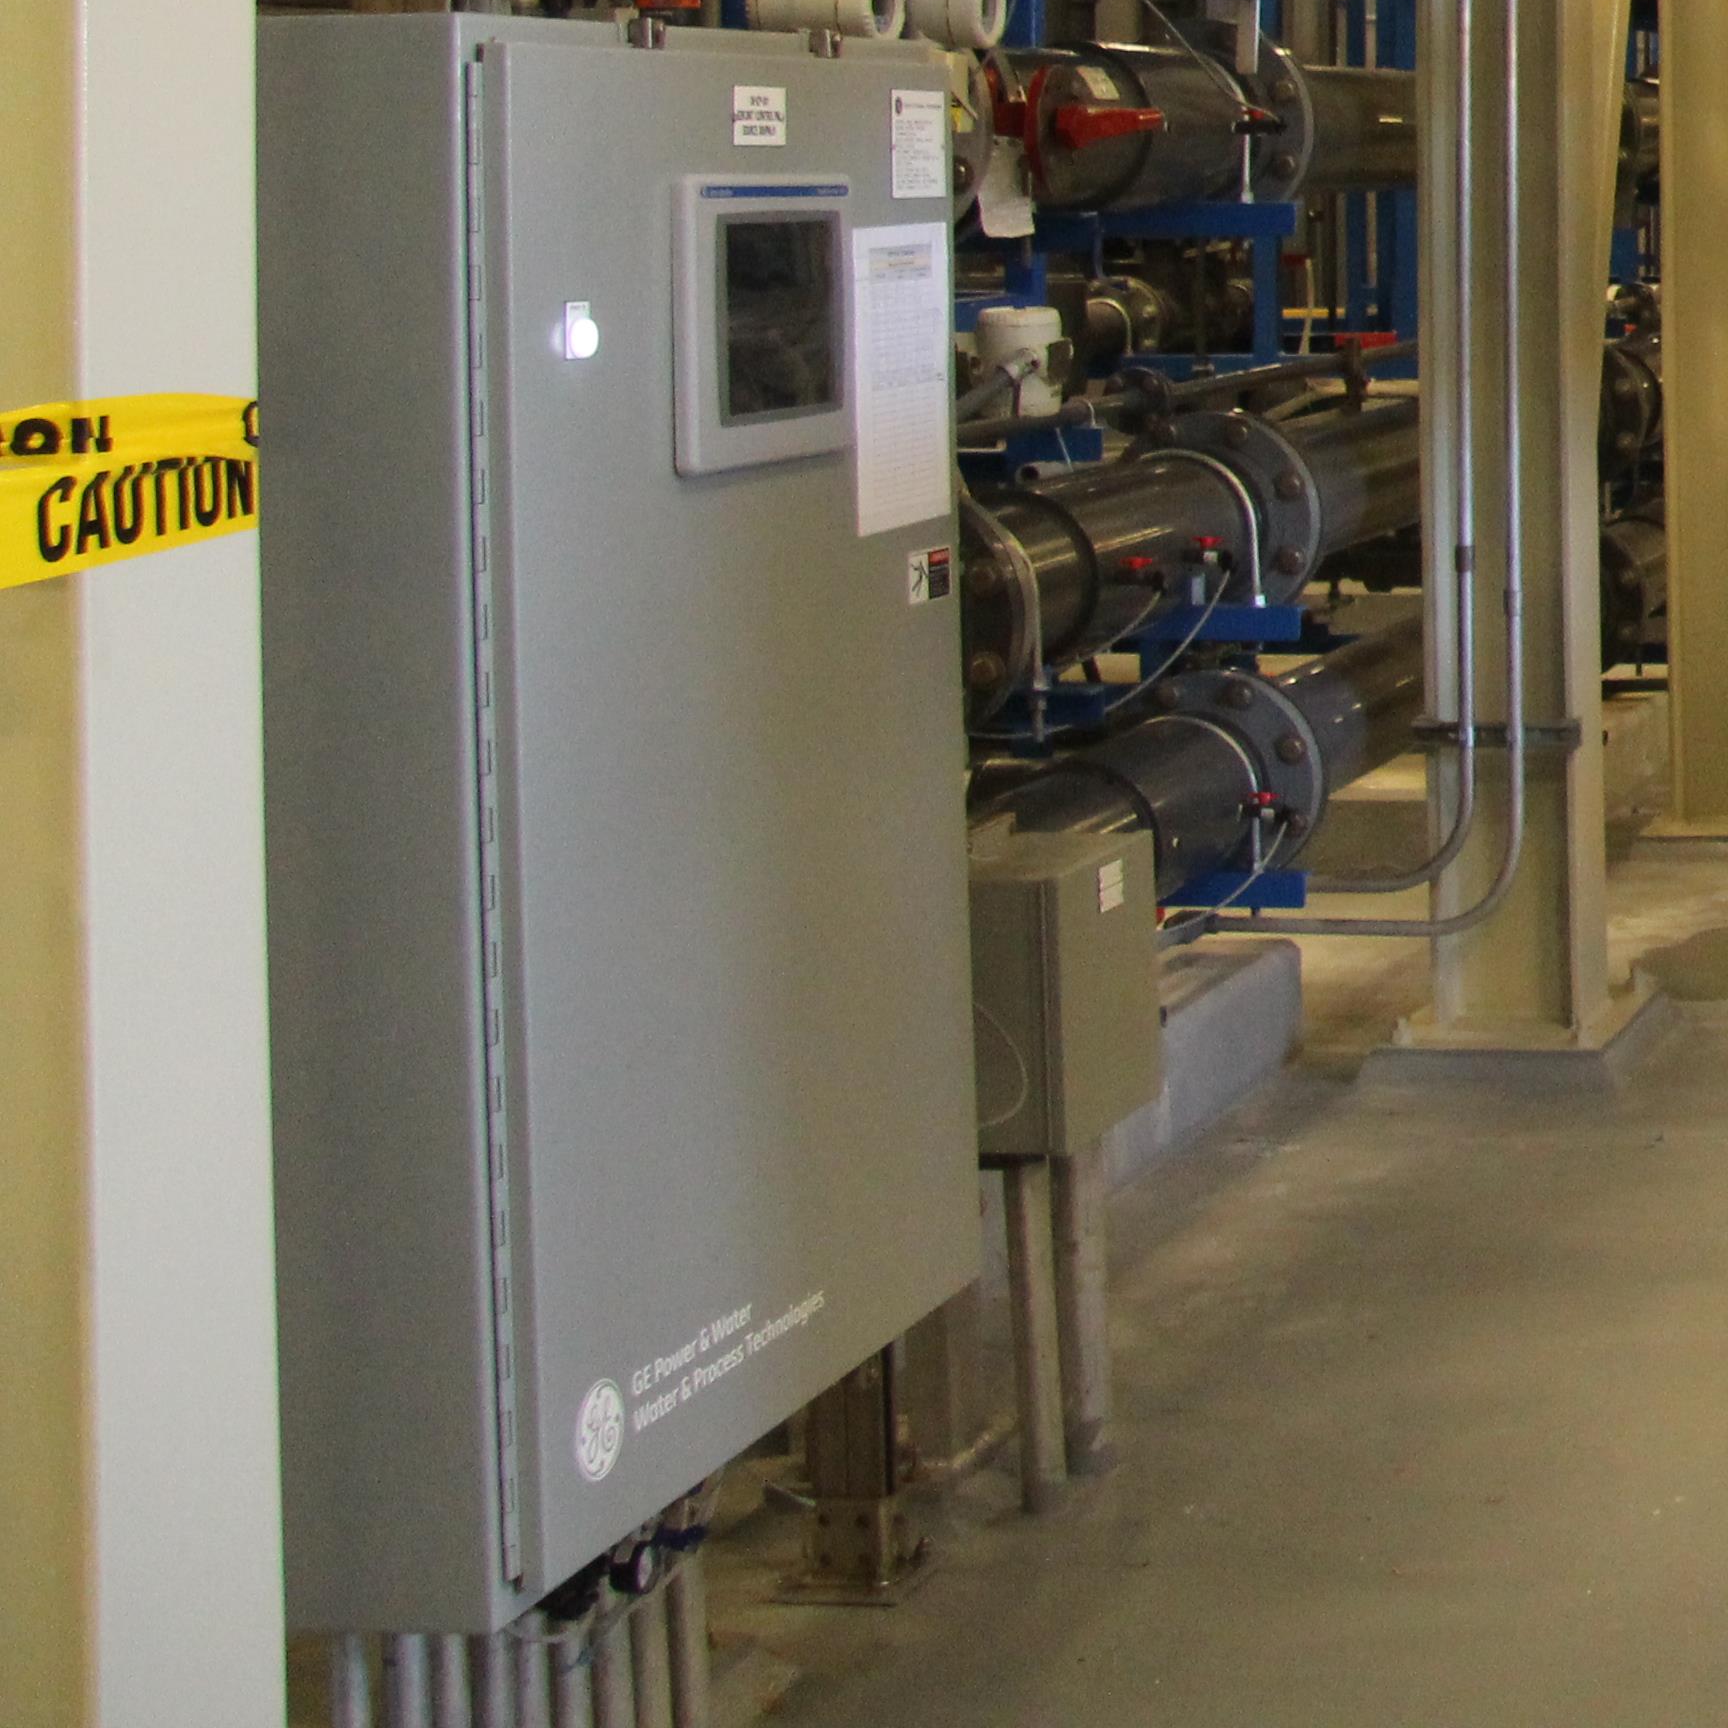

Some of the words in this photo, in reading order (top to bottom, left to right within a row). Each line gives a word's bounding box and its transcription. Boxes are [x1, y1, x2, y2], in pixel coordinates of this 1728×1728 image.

[38, 456, 255, 563] CAUTION
[632, 1364, 651, 1395] GE
[654, 1339, 698, 1384] Power
[711, 1303, 752, 1343] Water
[634, 1387, 680, 1431] Water
[694, 1344, 744, 1392] Process
